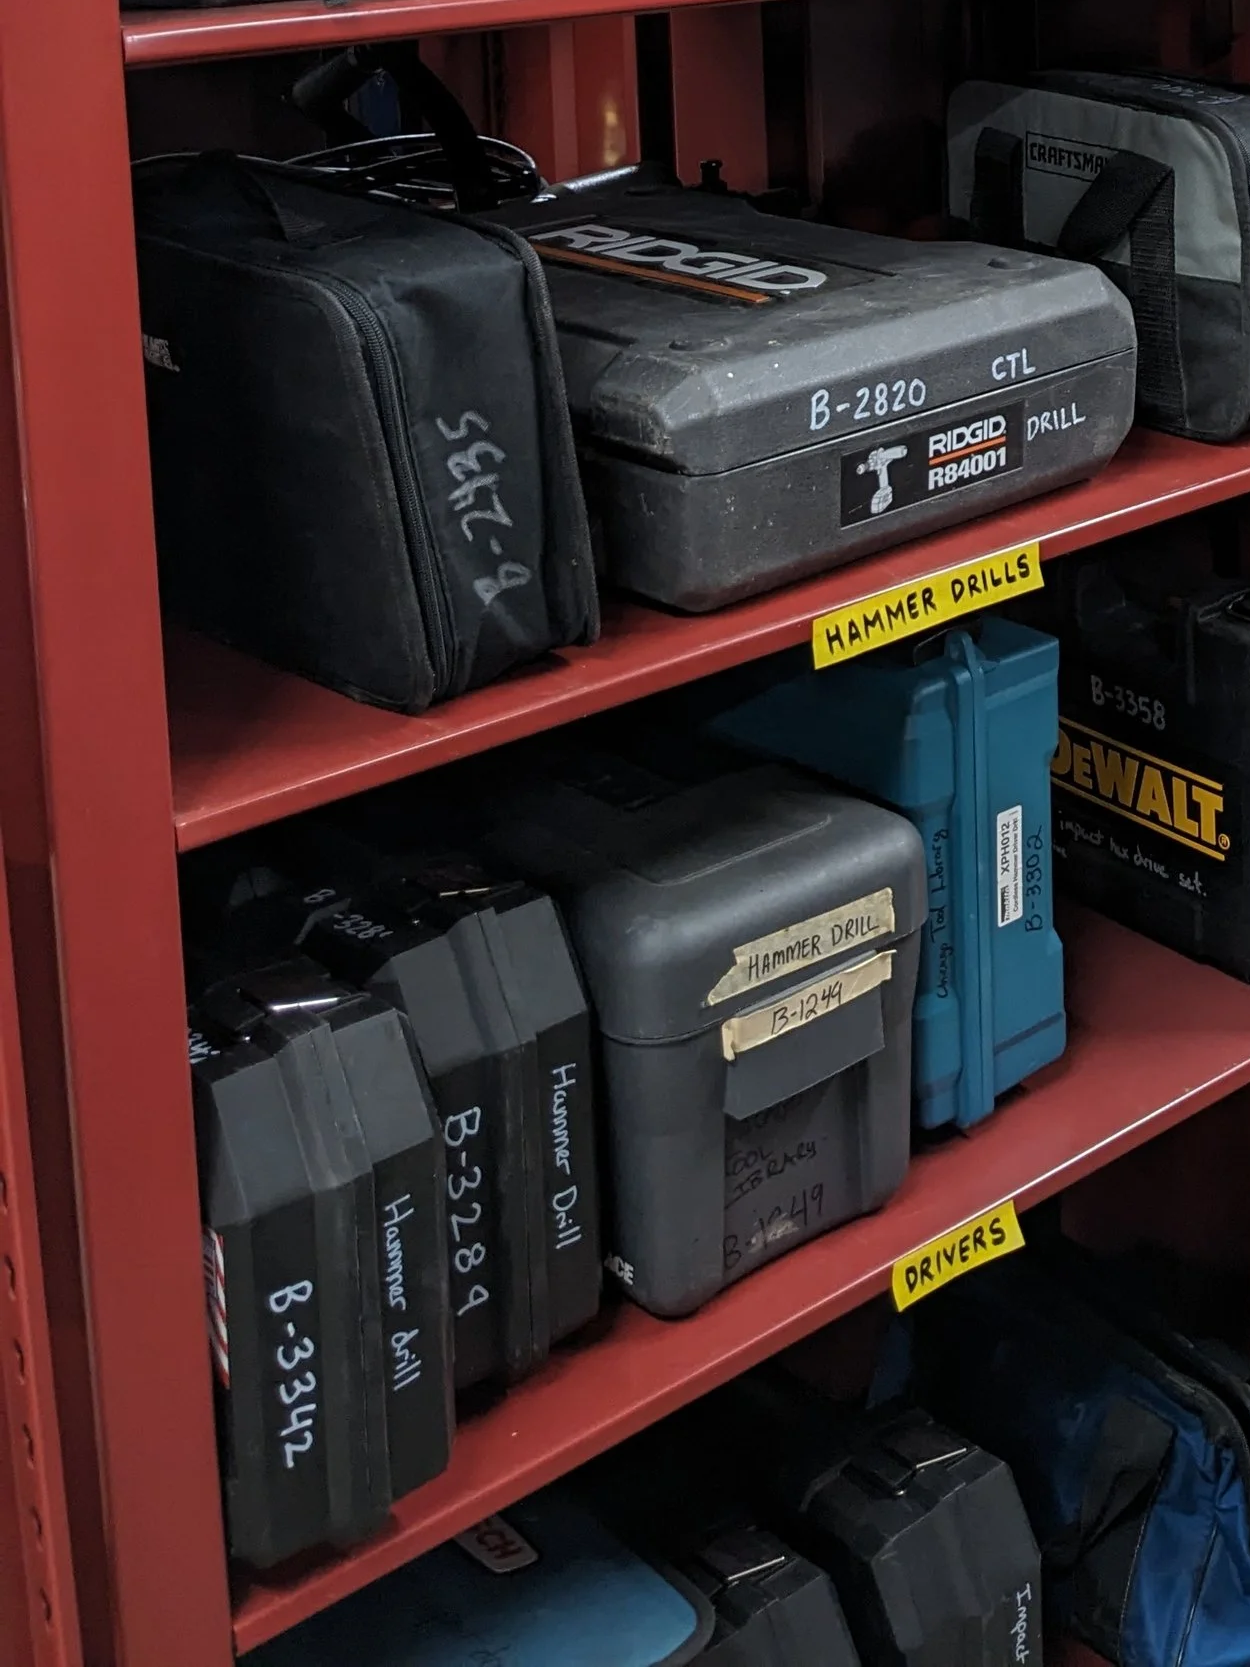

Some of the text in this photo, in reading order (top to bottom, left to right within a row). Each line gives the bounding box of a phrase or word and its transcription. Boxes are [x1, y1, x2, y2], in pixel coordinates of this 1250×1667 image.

[536, 224, 828, 291] RIDGID
[991, 348, 1036, 381] CTL
[810, 378, 927, 431] B-2820
[929, 415, 1006, 455] RIDGID
[1027, 402, 1086, 441] DRILL
[928, 447, 1007, 491] R84001
[825, 553, 1032, 652] HAMMER DRILLS
[1090, 674, 1166, 731] B-3358
[1001, 822, 1010, 876] XPH012
[1024, 825, 1043, 932] B-3302
[748, 914, 880, 978] HAMMER DRILL
[770, 980, 843, 1035] B-1249
[551, 1062, 582, 1249] Hammer Drill
[445, 1106, 489, 1316] B-3289
[384, 1193, 414, 1311] Hammer
[905, 1217, 1006, 1294] DRIVERS
[270, 1279, 317, 1470] B-3342
